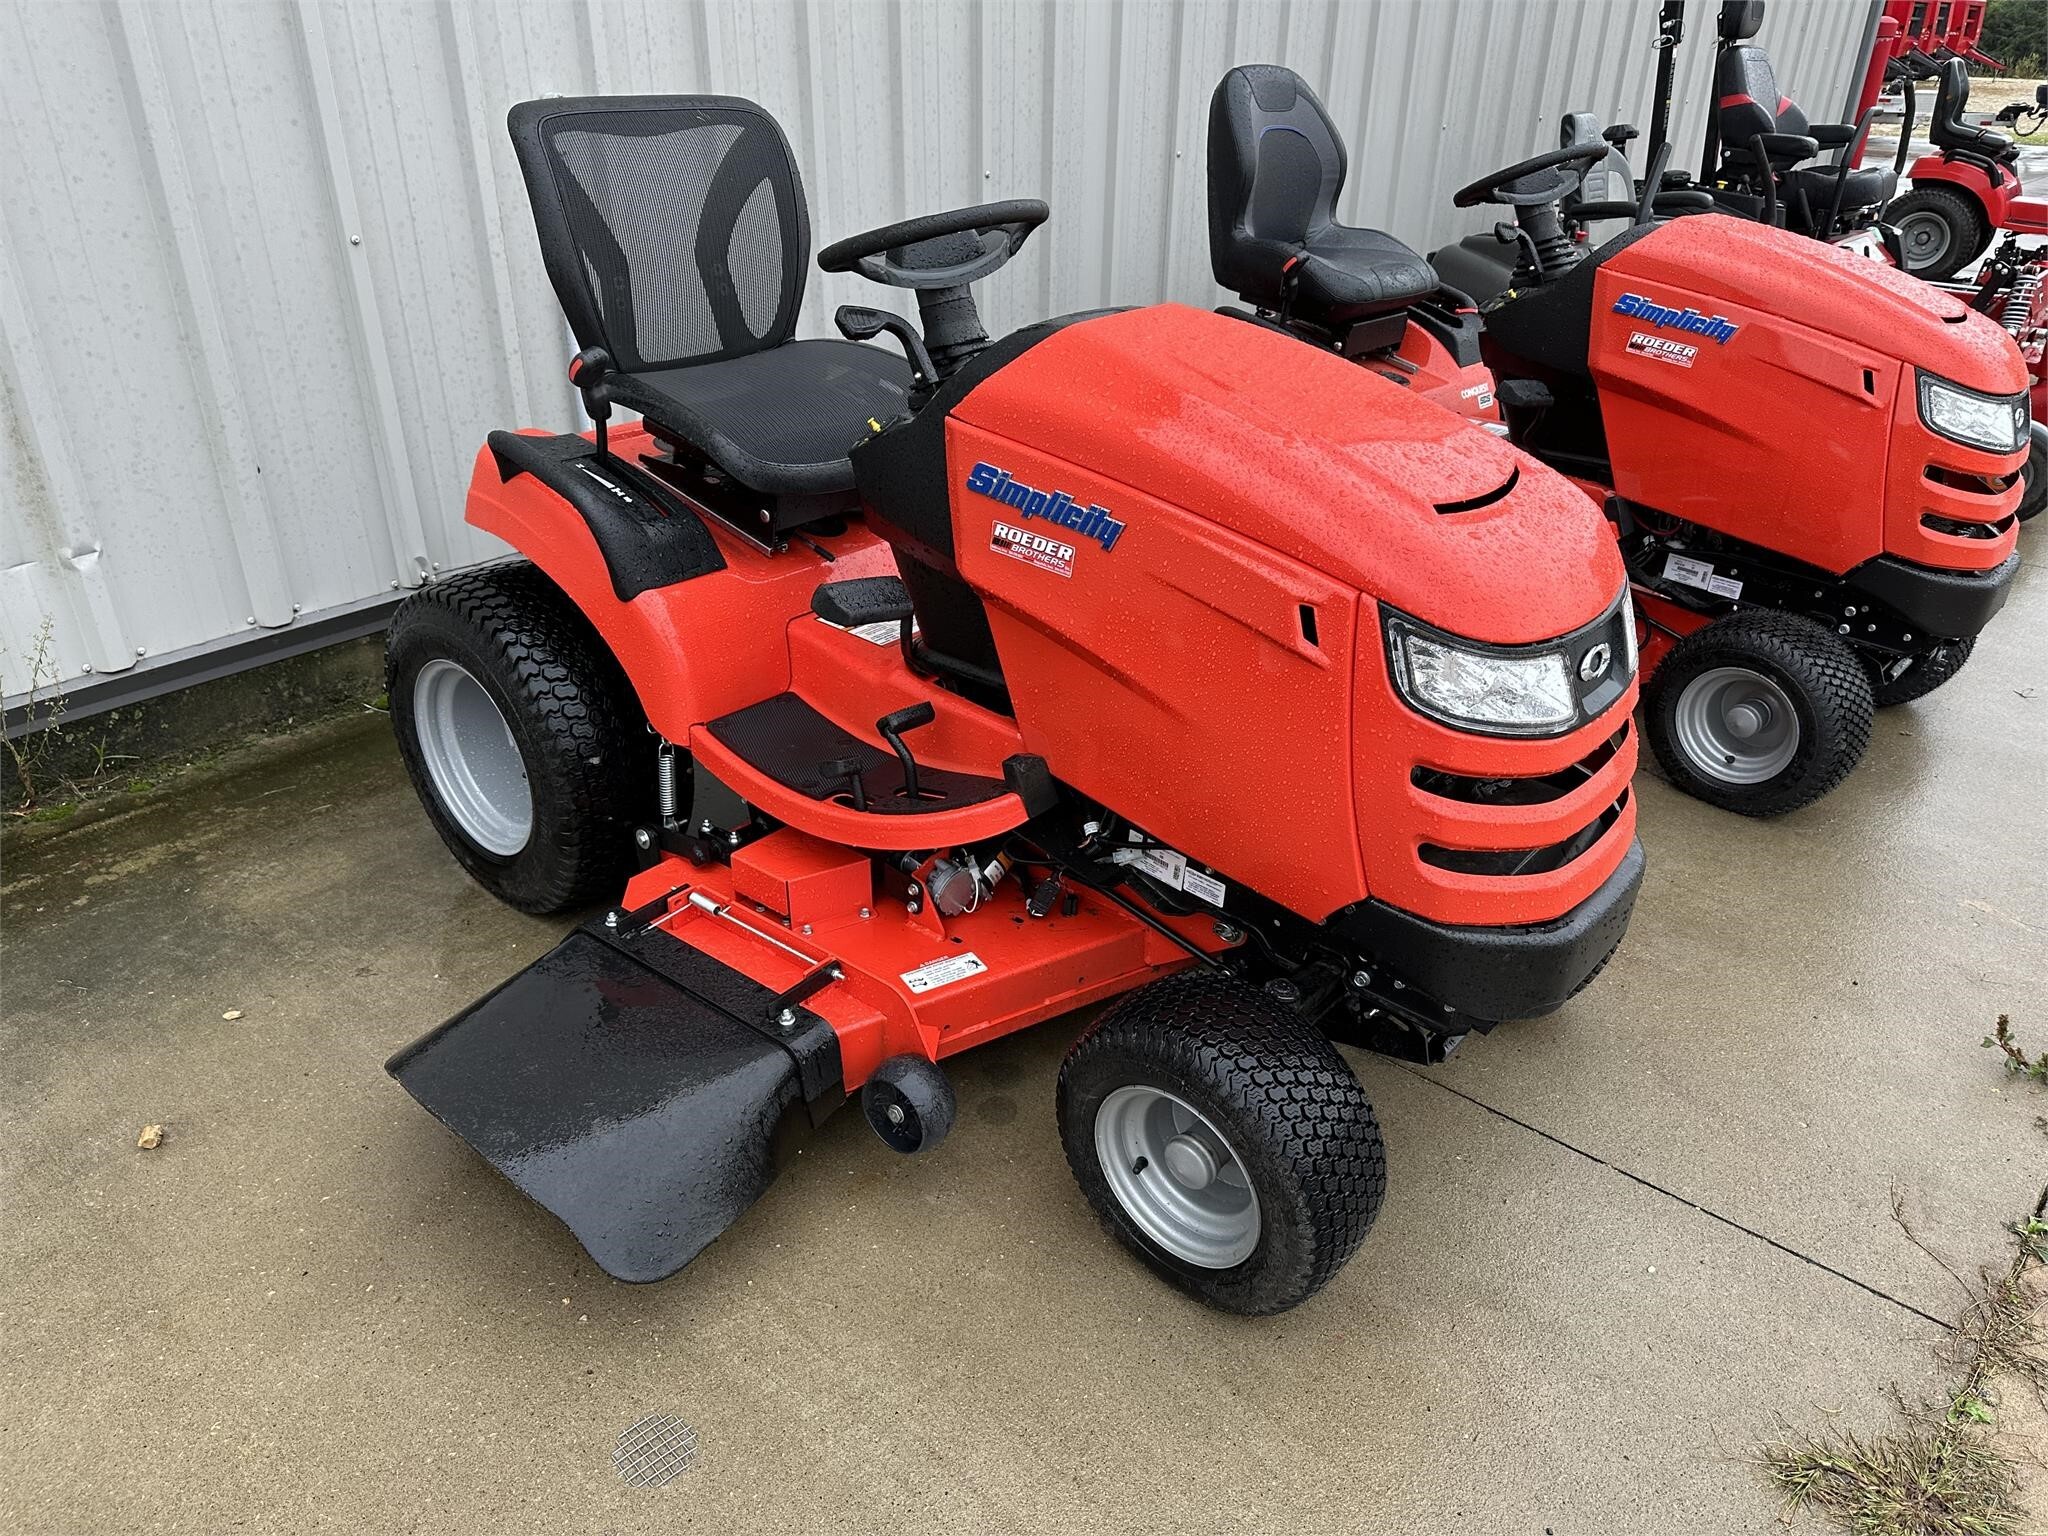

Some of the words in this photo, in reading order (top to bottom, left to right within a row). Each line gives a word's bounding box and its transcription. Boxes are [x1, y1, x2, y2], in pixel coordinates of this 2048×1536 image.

[1611, 292, 1741, 346] Simplicity
[1631, 334, 1696, 358] ROEDER
[1643, 347, 1688, 363] BROTHERS
[1461, 383, 1489, 399] CONQUEST
[966, 461, 1127, 553] Simplicity
[994, 524, 1073, 561] ROEDER
[1011, 544, 1066, 569] BROTHERS
